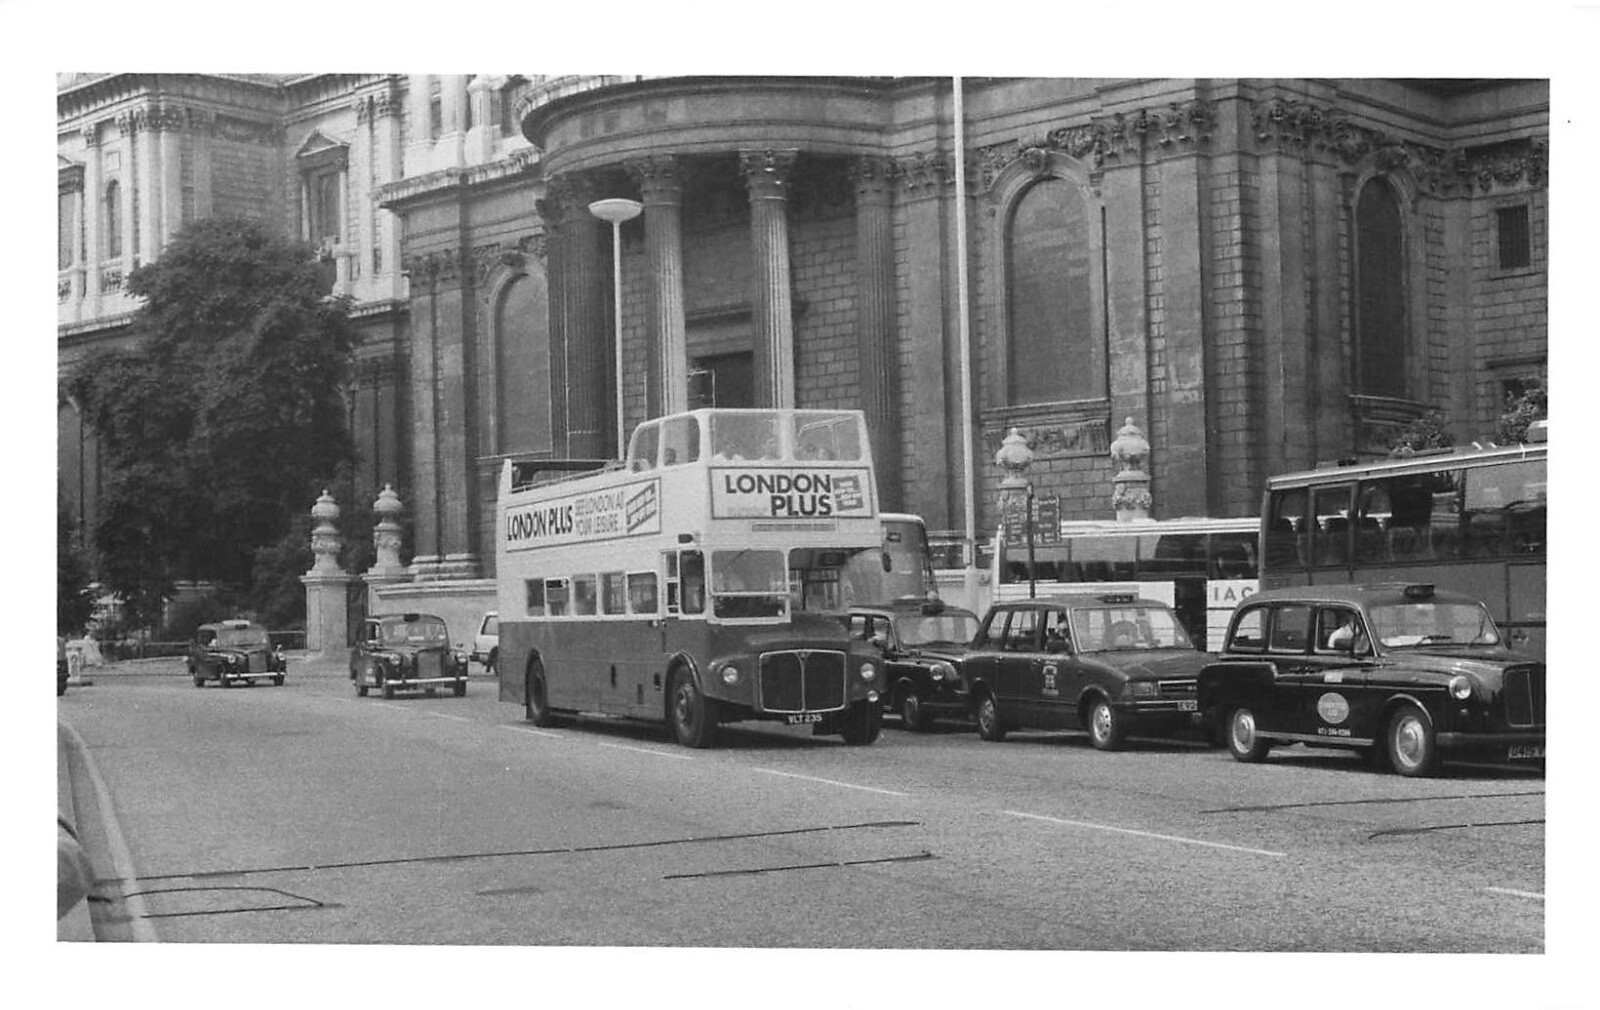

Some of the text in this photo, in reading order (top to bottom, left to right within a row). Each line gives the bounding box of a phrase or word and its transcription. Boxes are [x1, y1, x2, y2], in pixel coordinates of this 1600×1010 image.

[725, 474, 832, 494] LONDON
[585, 494, 615, 516] LONDON
[770, 494, 832, 516] PLUS
[507, 505, 573, 541] LONDON PLUS
[594, 513, 619, 534] LEISURE
